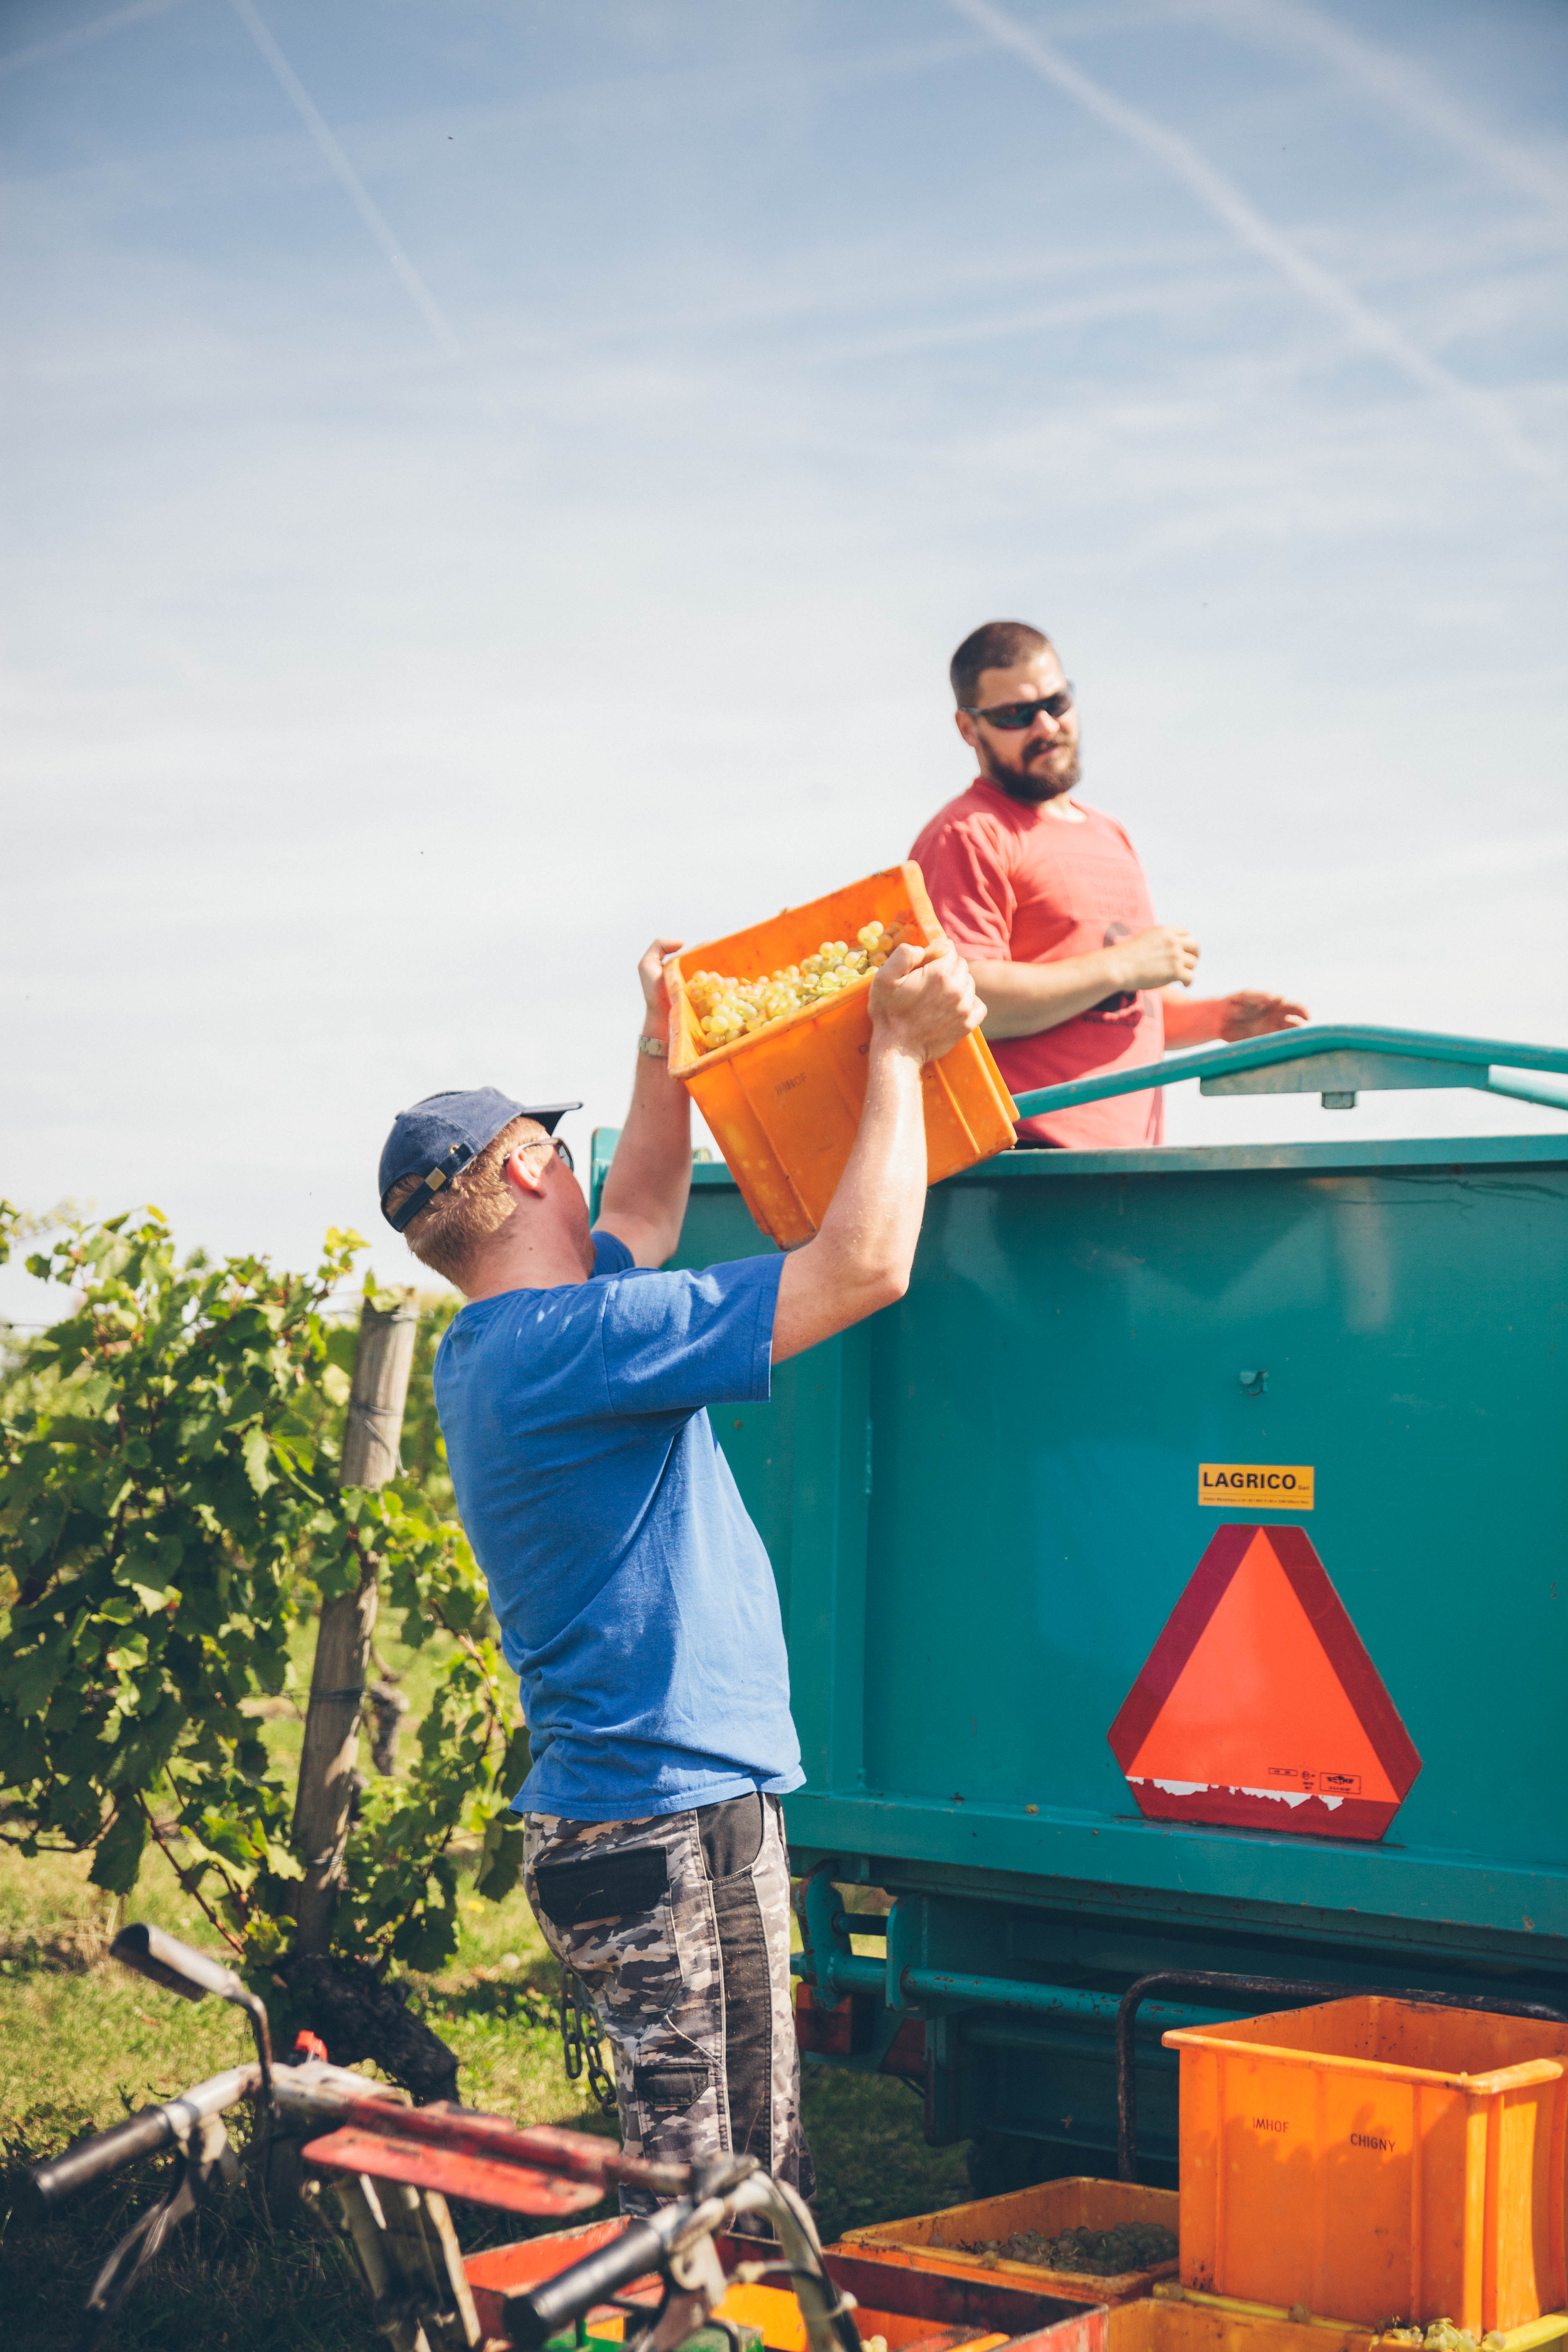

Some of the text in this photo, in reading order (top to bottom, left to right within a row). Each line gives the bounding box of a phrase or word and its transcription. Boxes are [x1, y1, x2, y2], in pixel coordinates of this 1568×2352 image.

[1203, 1472, 1296, 1490] LAGRICO
[1253, 2117, 1395, 2152] IMHOF CHIGNY
